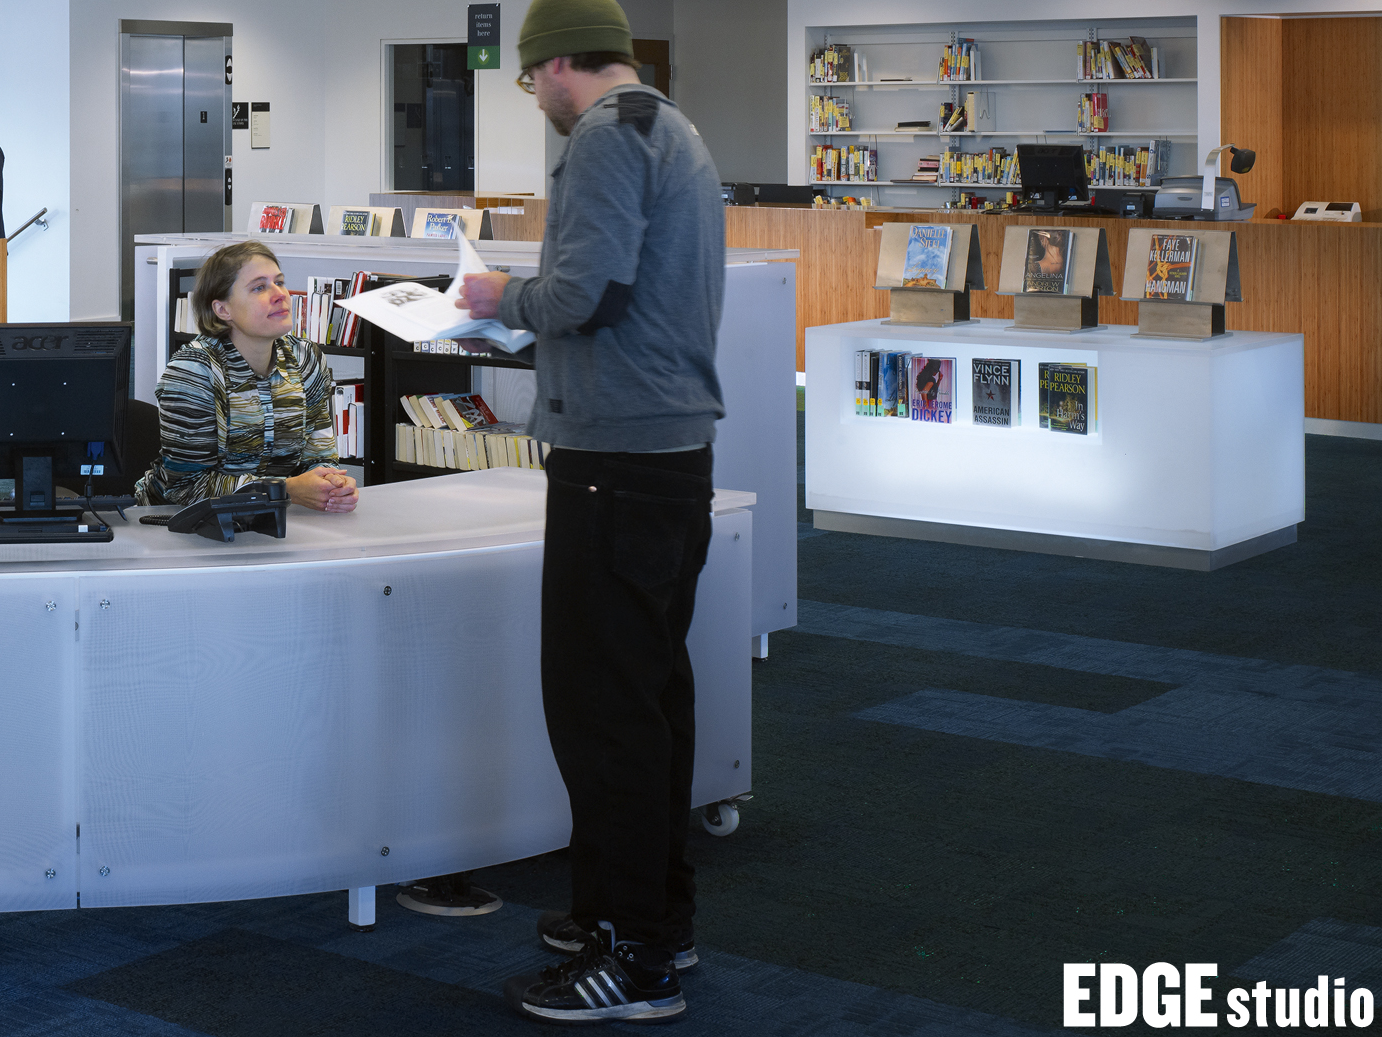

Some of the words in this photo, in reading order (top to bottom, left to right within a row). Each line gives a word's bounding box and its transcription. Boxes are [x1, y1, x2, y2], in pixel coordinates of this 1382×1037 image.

[345, 215, 365, 223] RIDLEY
[427, 215, 446, 223] Robert
[429, 223, 448, 232] Parker
[910, 227, 947, 238] DANIELLE
[919, 237, 941, 249] STEEL
[1163, 239, 1180, 251] FAYE
[1149, 250, 1191, 262] KELLERMAN
[1145, 280, 1187, 294] HANGMAN
[11, 335, 70, 351] acer
[973, 364, 1009, 376] VINCE
[973, 374, 1009, 386] FLYNN
[1054, 373, 1081, 384] RIDLEY
[1050, 382, 1085, 394] PEARSON
[912, 399, 926, 407] ERIC
[928, 400, 952, 410] JEROME
[1075, 401, 1084, 411] In
[912, 408, 952, 424] DICKEY
[973, 405, 1010, 417] AMERICAN
[1056, 408, 1085, 420] Harm's
[974, 415, 1009, 425] ASSASSIN
[1069, 420, 1085, 431] Way
